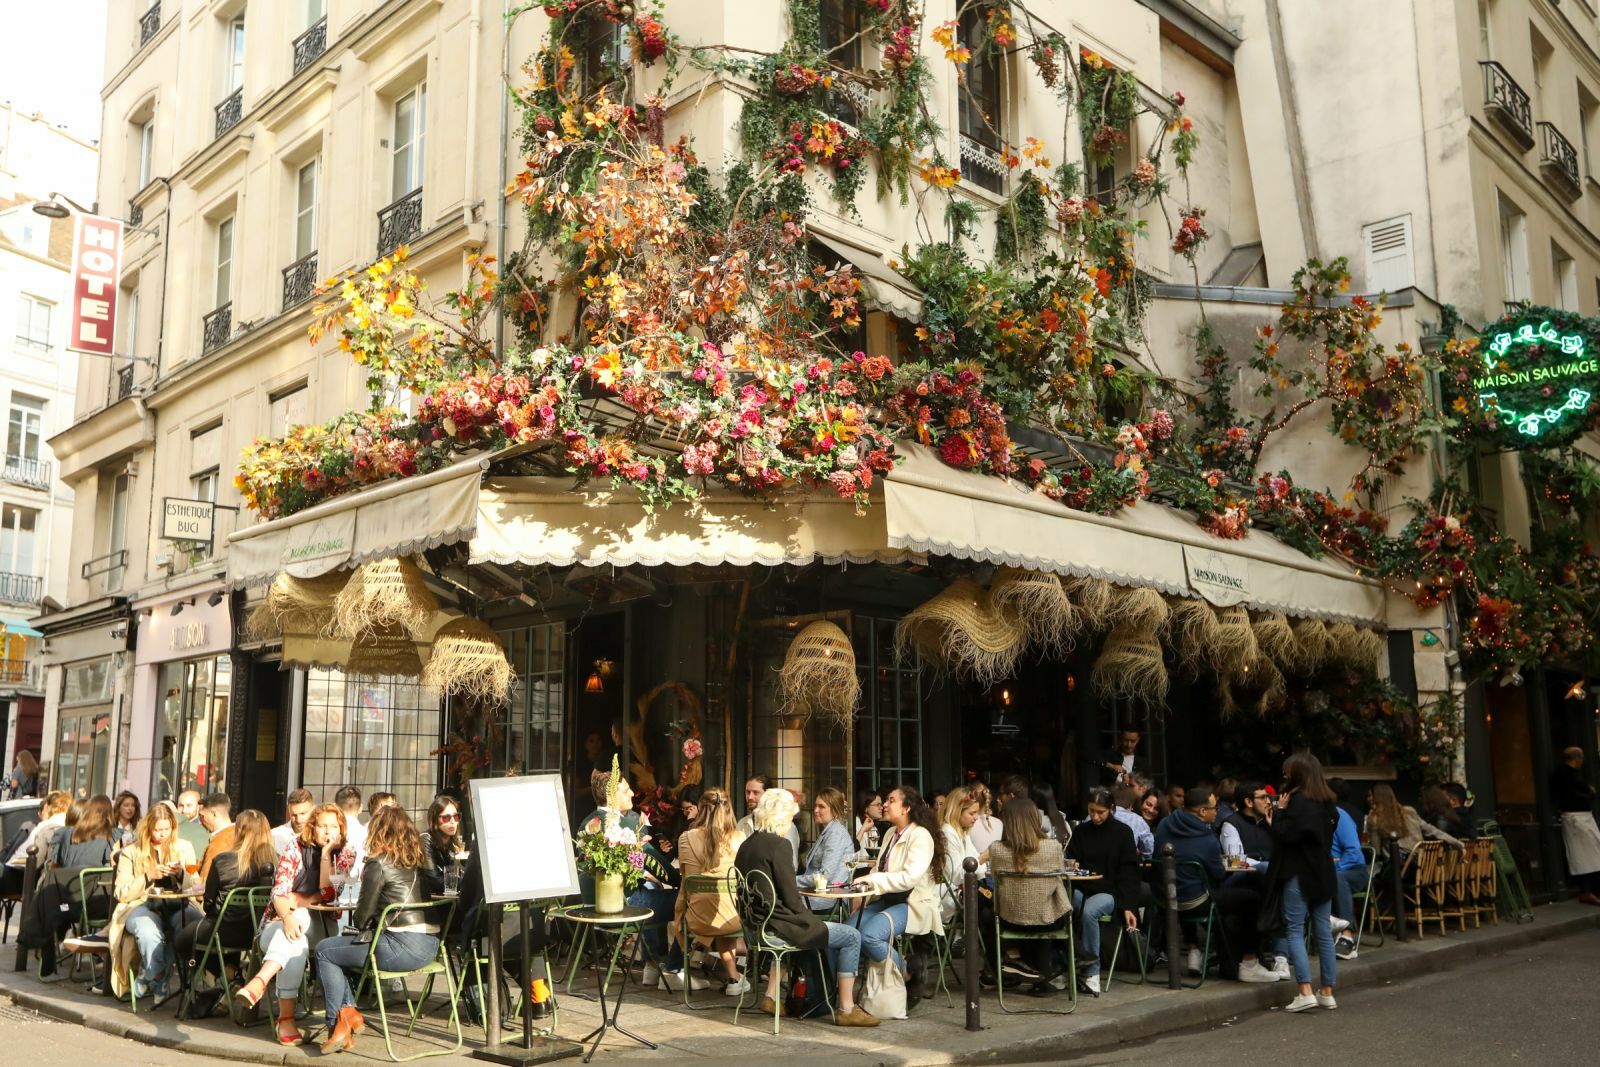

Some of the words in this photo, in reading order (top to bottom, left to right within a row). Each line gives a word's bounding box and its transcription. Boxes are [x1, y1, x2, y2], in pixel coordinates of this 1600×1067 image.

[80, 225, 115, 344] HOTEL
[1473, 372, 1530, 389] MAISON
[1533, 360, 1598, 380] SAUVAGE
[166, 503, 212, 519] ESTHETIQUE
[177, 520, 199, 534] BUCI
[1193, 567, 1217, 582] MAISON
